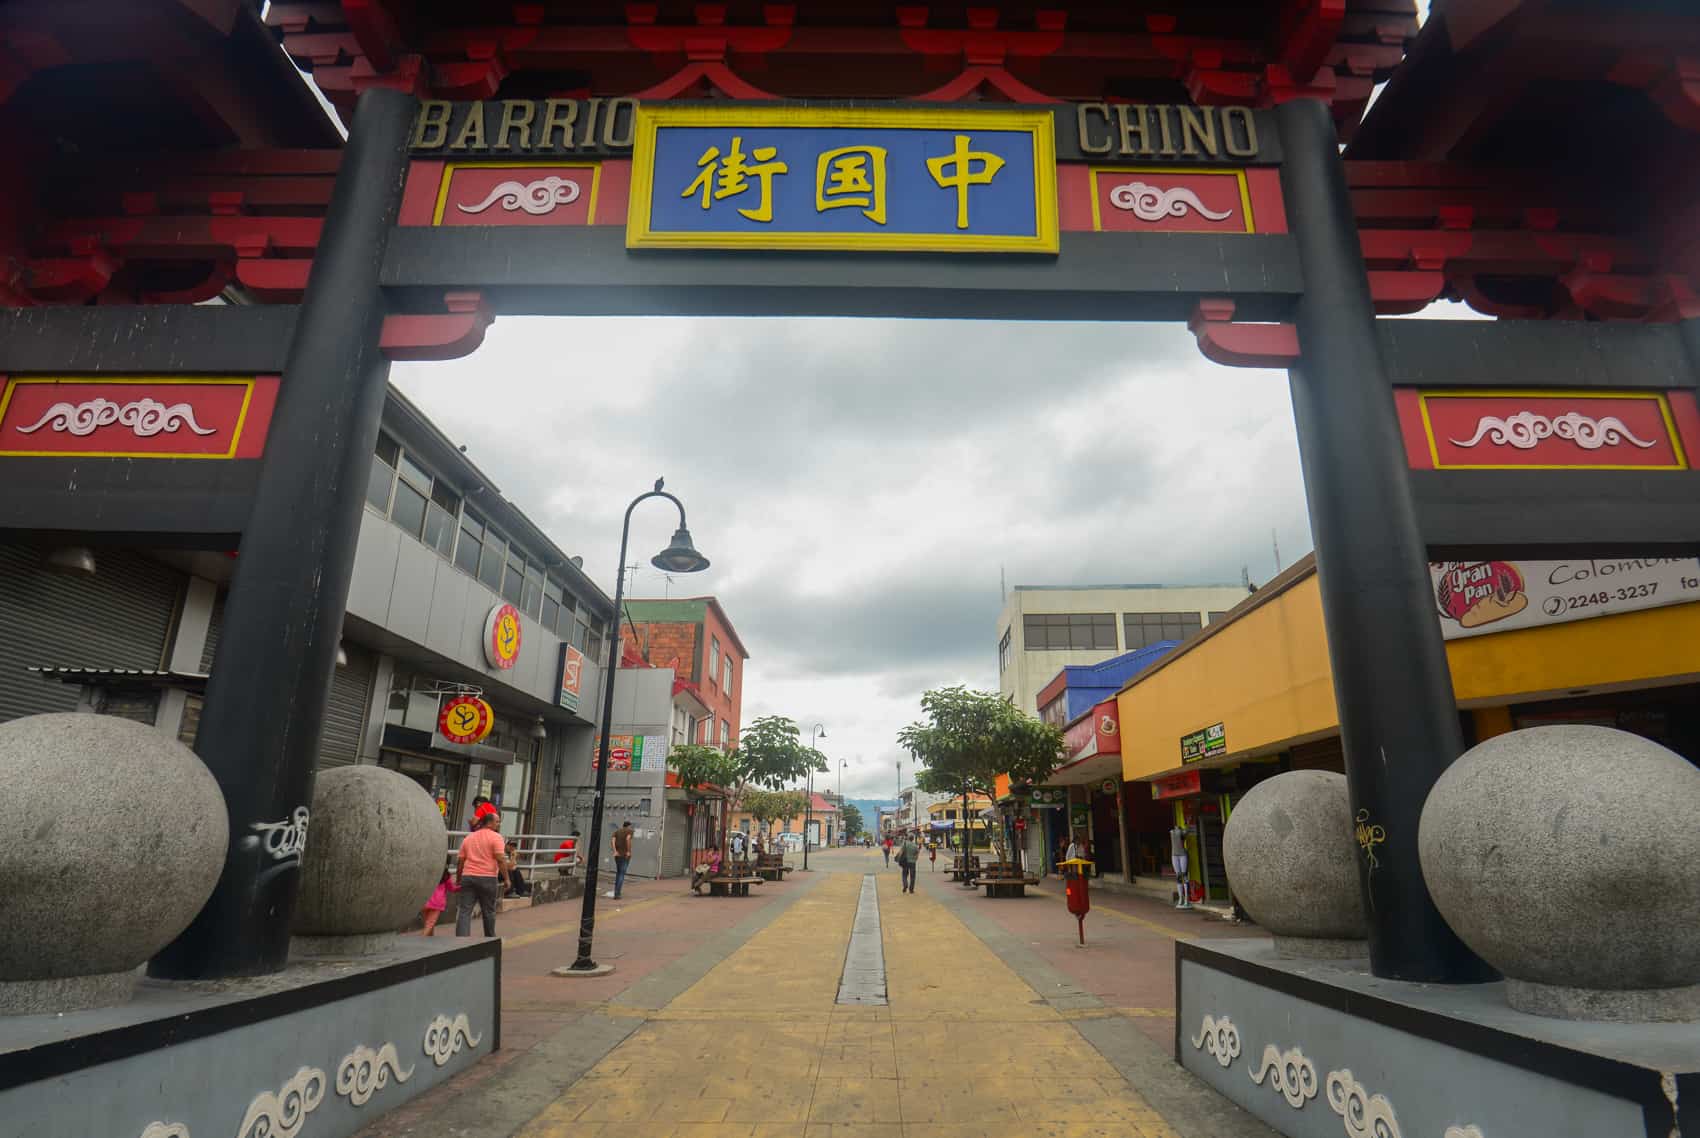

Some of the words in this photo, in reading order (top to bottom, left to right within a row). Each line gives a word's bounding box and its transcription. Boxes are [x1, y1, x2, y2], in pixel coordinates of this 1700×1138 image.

[410, 98, 634, 149] BARRIO
[1077, 102, 1259, 157] CHINO
[1568, 582, 1659, 609] 2248-3237
